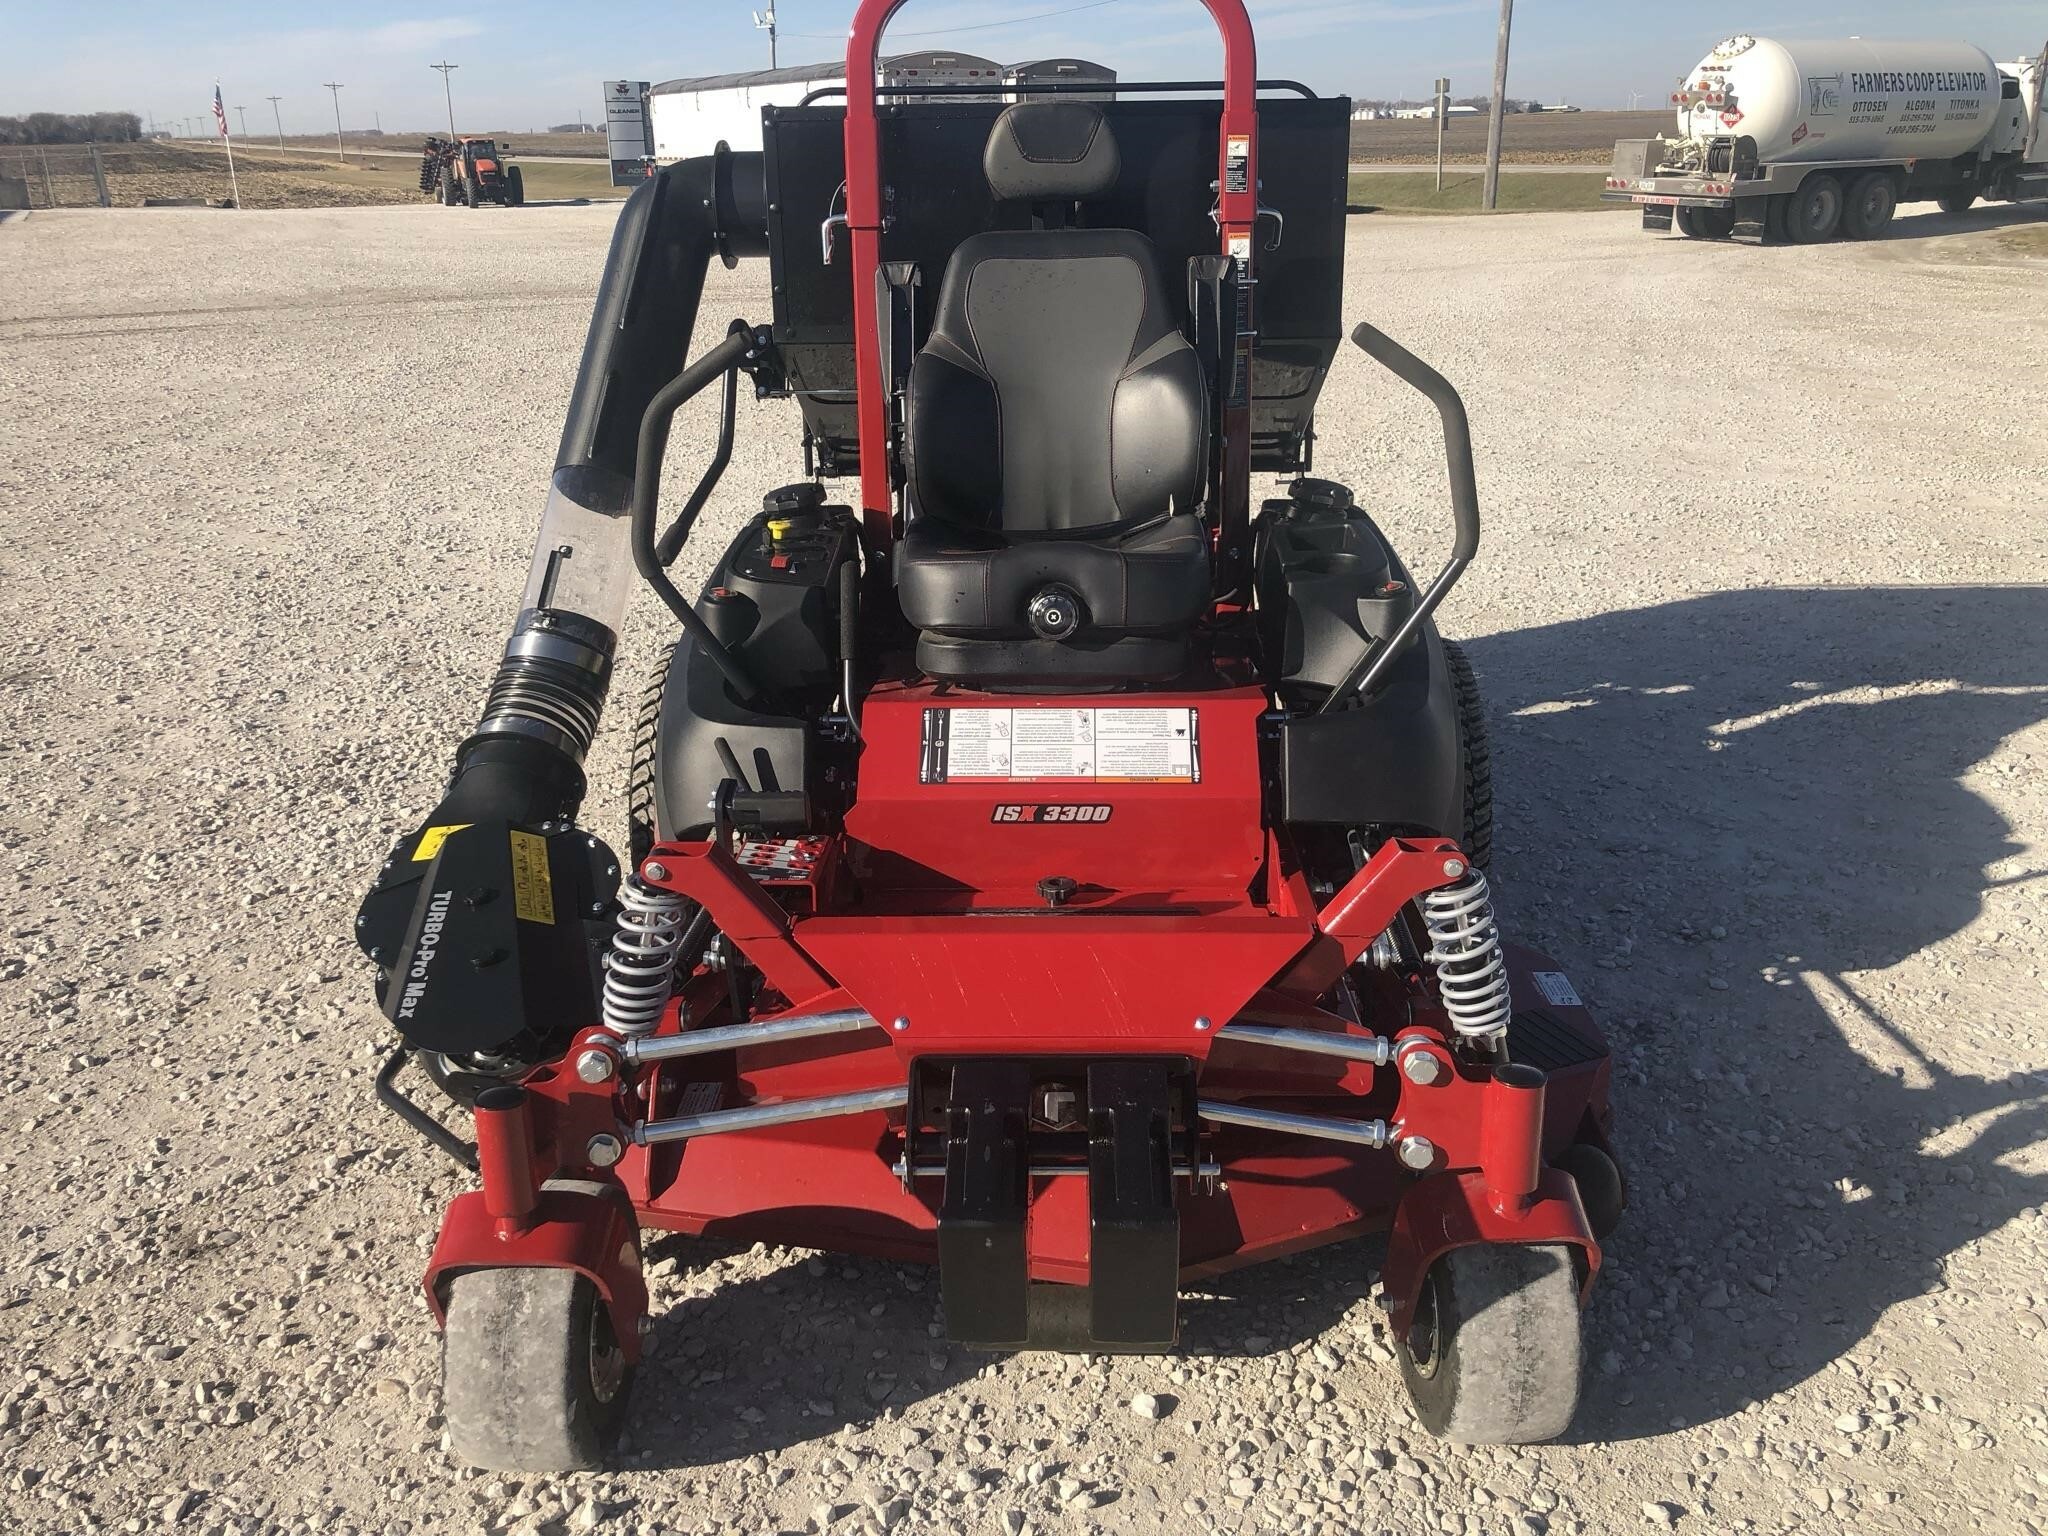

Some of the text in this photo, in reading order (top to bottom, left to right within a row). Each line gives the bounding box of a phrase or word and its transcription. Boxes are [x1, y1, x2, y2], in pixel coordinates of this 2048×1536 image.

[1852, 72, 1986, 92] FARMERS COOP ELEVATOR
[1853, 101, 1888, 112] OTTOSEN
[1905, 100, 1936, 111] ALGONA
[1950, 99, 1979, 110] TITONKA
[993, 806, 1110, 821] ISX 3300
[399, 982, 427, 1018] Max
